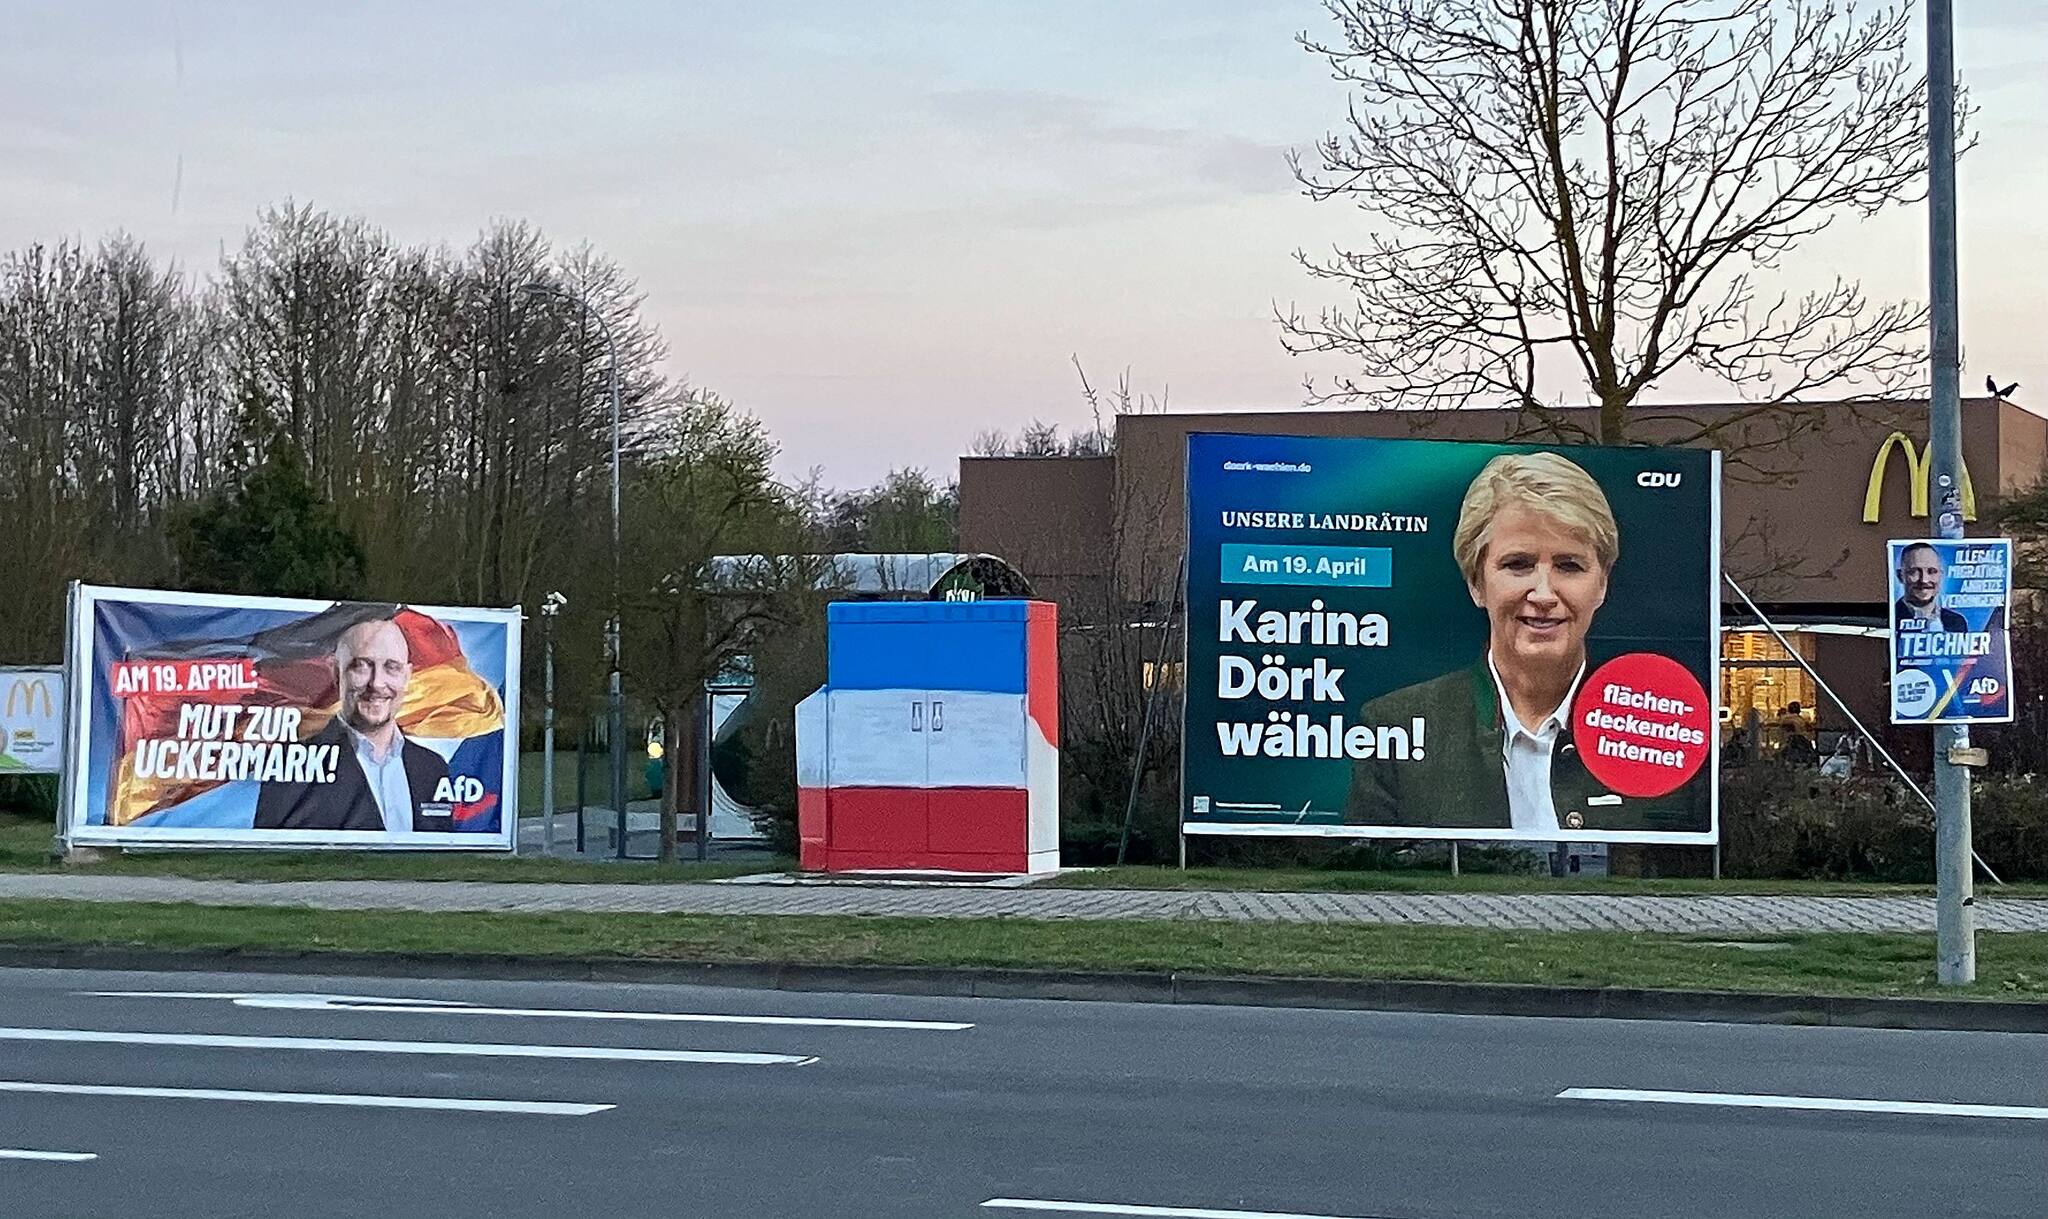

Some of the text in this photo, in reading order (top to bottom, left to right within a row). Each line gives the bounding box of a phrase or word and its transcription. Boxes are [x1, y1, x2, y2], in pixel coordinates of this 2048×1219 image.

[1637, 472, 1681, 487] CDU
[1222, 511, 1428, 532] UNSERE LANDRÄTIN
[1243, 555, 1366, 578] Am 19. April
[1220, 599, 1389, 647] Karina
[1899, 632, 1991, 657] TEICHNER
[116, 663, 258, 692] AM 19. APRIL:
[1218, 654, 1345, 702] Dörk
[1969, 677, 1999, 695] AfD
[1603, 684, 1694, 716] flächen-
[177, 703, 301, 743] MUT ZUR
[1216, 711, 1426, 761] wählen!
[1585, 709, 1705, 745] deckendes
[134, 739, 340, 783] UCKERMARK!
[1597, 736, 1685, 768] Internet
[433, 775, 484, 803] AfD
